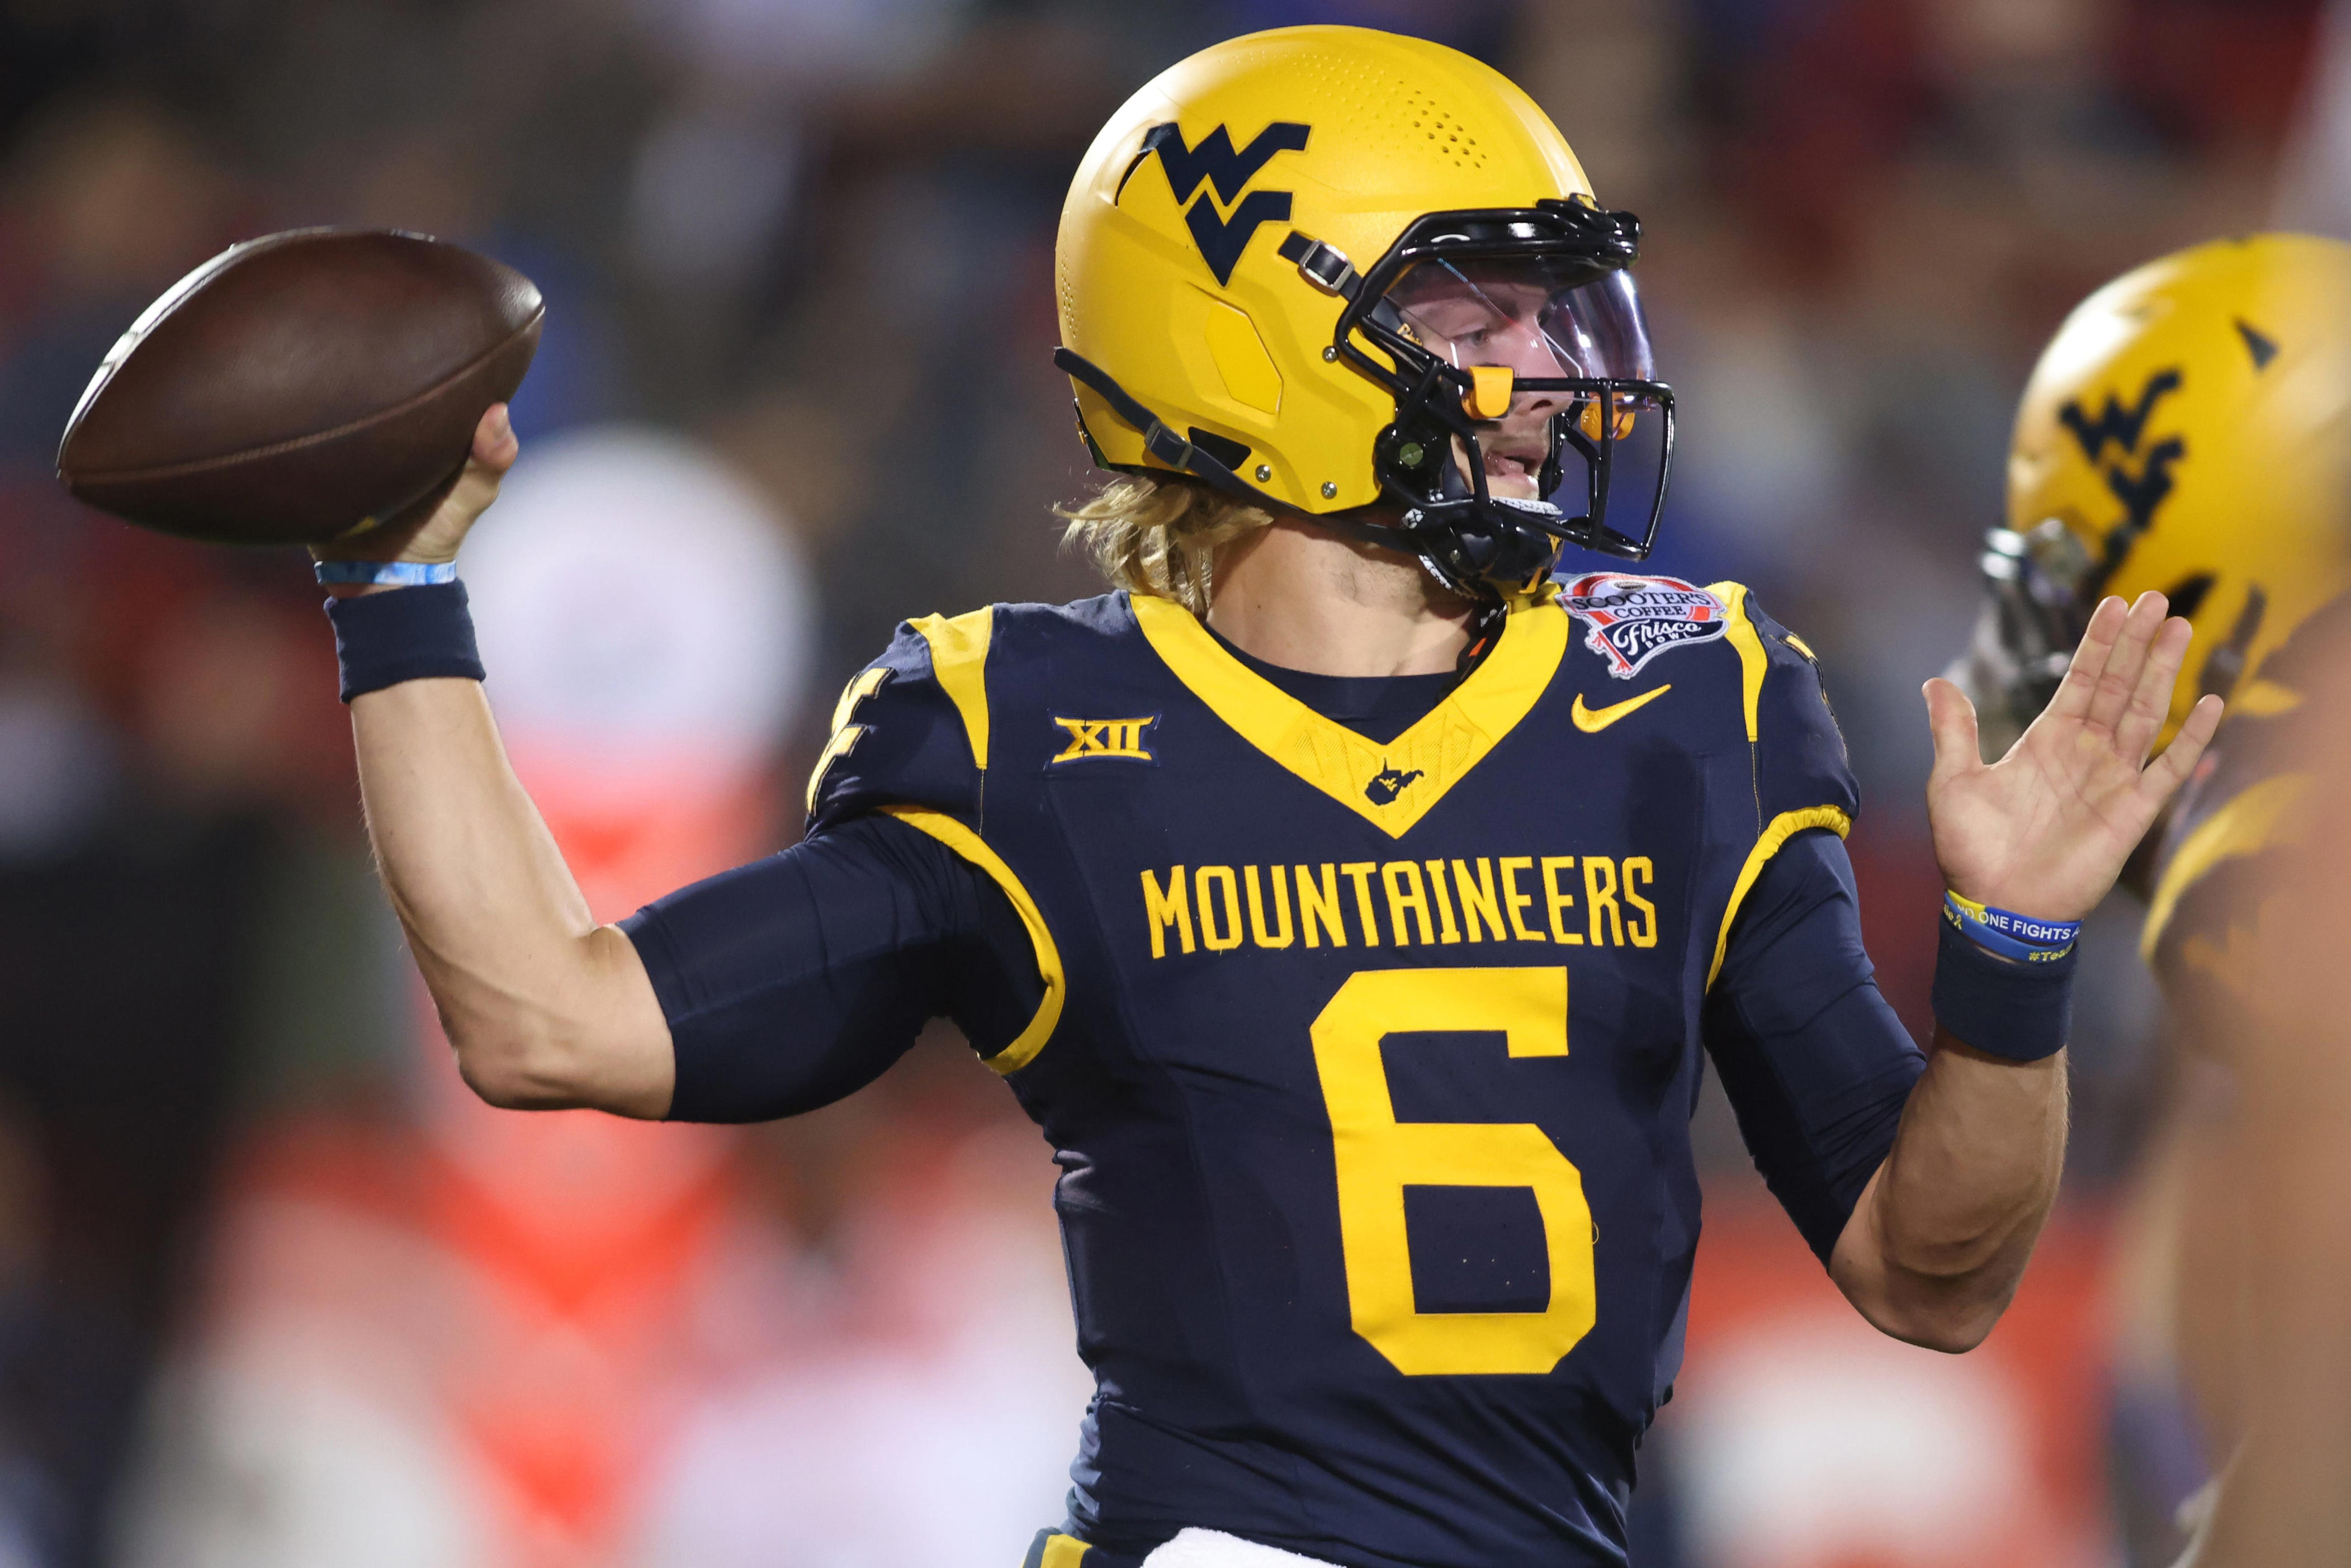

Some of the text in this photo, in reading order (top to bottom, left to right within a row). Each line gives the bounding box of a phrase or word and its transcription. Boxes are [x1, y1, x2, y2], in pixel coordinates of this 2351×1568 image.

[1571, 591, 1711, 610] SCOOTER'S
[1614, 605, 1687, 618] COFFEE
[1612, 619, 1702, 656] Frisco
[1645, 632, 1692, 648] BOWL
[1052, 716, 1154, 764] XII
[1140, 856, 1658, 959] MOUNTAINEERS
[1978, 911, 2009, 929] ONE
[2013, 920, 2071, 940] FIGHTS
[1309, 965, 1597, 1376] 6
